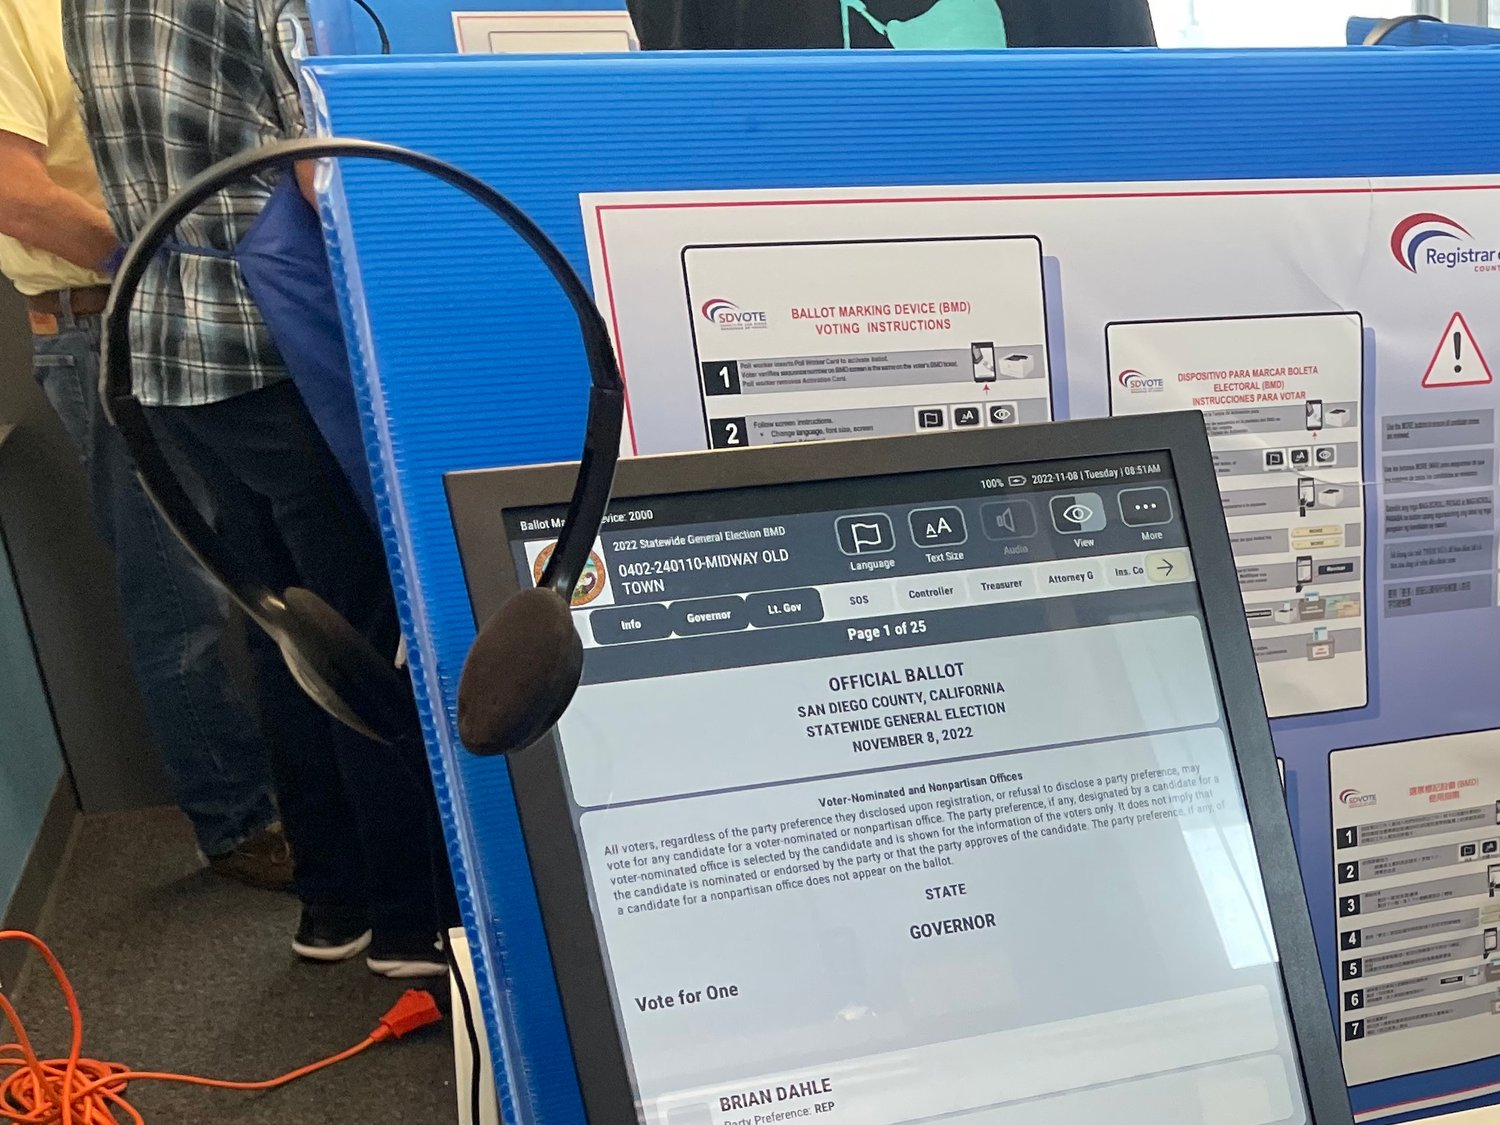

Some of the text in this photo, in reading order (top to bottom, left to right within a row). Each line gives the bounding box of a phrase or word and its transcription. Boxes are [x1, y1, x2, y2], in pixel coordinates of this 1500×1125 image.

[1425, 247, 1496, 268] Registrar
[718, 310, 767, 324] SDVOTE
[791, 301, 970, 319] BALLOT MARKING DEVICE (BMD)
[815, 318, 950, 334] VOTING INSTRUCTIONS
[718, 366, 731, 388] 1
[1177, 365, 1318, 382] DISPOSITIVO PARA MARCAR BOLETA
[1129, 377, 1164, 389] SDVOTE
[1213, 380, 1284, 392] ELECTORAL (BMD)
[1192, 390, 1305, 405] INSTRUCCIONES PARA VOTAR
[725, 422, 739, 445] 2
[1085, 467, 1119, 481] Tuesday
[1125, 464, 1161, 477] 08:51AM
[980, 478, 1004, 488] 100%
[1032, 470, 1079, 486] 2022-11-08
[628, 509, 653, 520] 2000
[519, 518, 554, 530] Ballot
[612, 525, 785, 551] 2022 Statewide General Election BMD
[1073, 538, 1094, 547] View
[1141, 531, 1162, 540] More
[618, 548, 788, 577] 0402-240110-MIDWAY OLD
[925, 551, 963, 562] Text Size
[849, 559, 895, 571] Language
[980, 580, 1022, 590] Treasurer
[1048, 573, 1084, 583] Attorney
[621, 578, 664, 594] TOWN
[908, 586, 953, 598] Controller
[849, 595, 868, 605] SOS
[782, 603, 801, 612] Gov
[686, 610, 731, 622] Governor
[620, 618, 641, 629] Info
[847, 619, 926, 641] Page 1 of 25
[828, 662, 963, 691] OFFICIAL BALLOT
[797, 682, 1004, 717] SAN DIEGO COUNTY, CALIFORNIA
[806, 701, 1005, 737] STATEWIDE GENERAL ELECTION
[852, 726, 973, 752] NOVEMBER 8, 2022
[817, 772, 1023, 807] Voter-Nominated and Nonpartisan Offices
[1345, 830, 1353, 844] 1
[1345, 865, 1355, 879] 2
[925, 883, 966, 900] STATE
[1347, 899, 1356, 912] 3
[909, 913, 996, 939] GOVERNOR
[1348, 932, 1357, 945] 4
[1349, 963, 1357, 976] 5
[634, 985, 738, 1011] Vote for One
[1351, 993, 1359, 1006] 6
[1351, 1022, 1360, 1036] 7
[719, 1077, 832, 1111] BRIAN DAHLE
